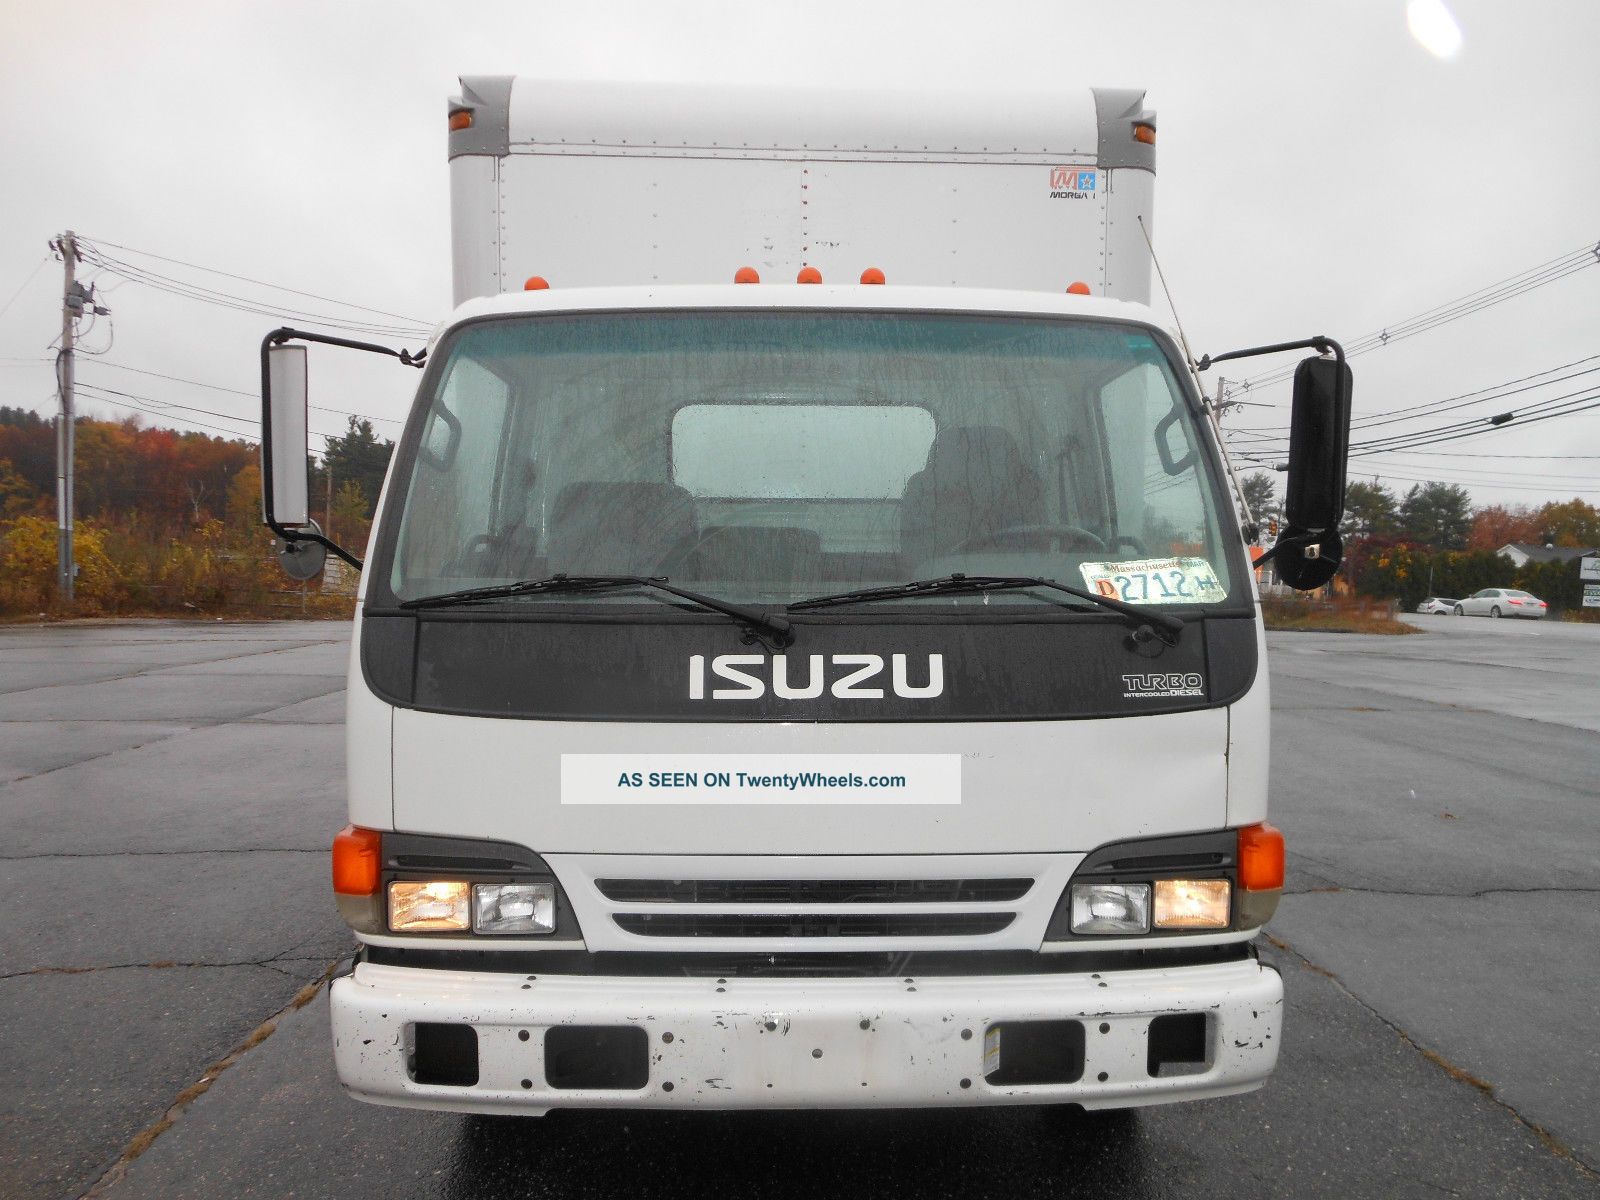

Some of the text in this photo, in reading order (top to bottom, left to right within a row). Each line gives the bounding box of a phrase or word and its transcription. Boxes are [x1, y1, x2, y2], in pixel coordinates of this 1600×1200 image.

[1114, 570, 1193, 602] 2712
[689, 653, 944, 700] ISUZU
[1121, 673, 1203, 691] TURBO
[1169, 689, 1205, 697] DIESEL
